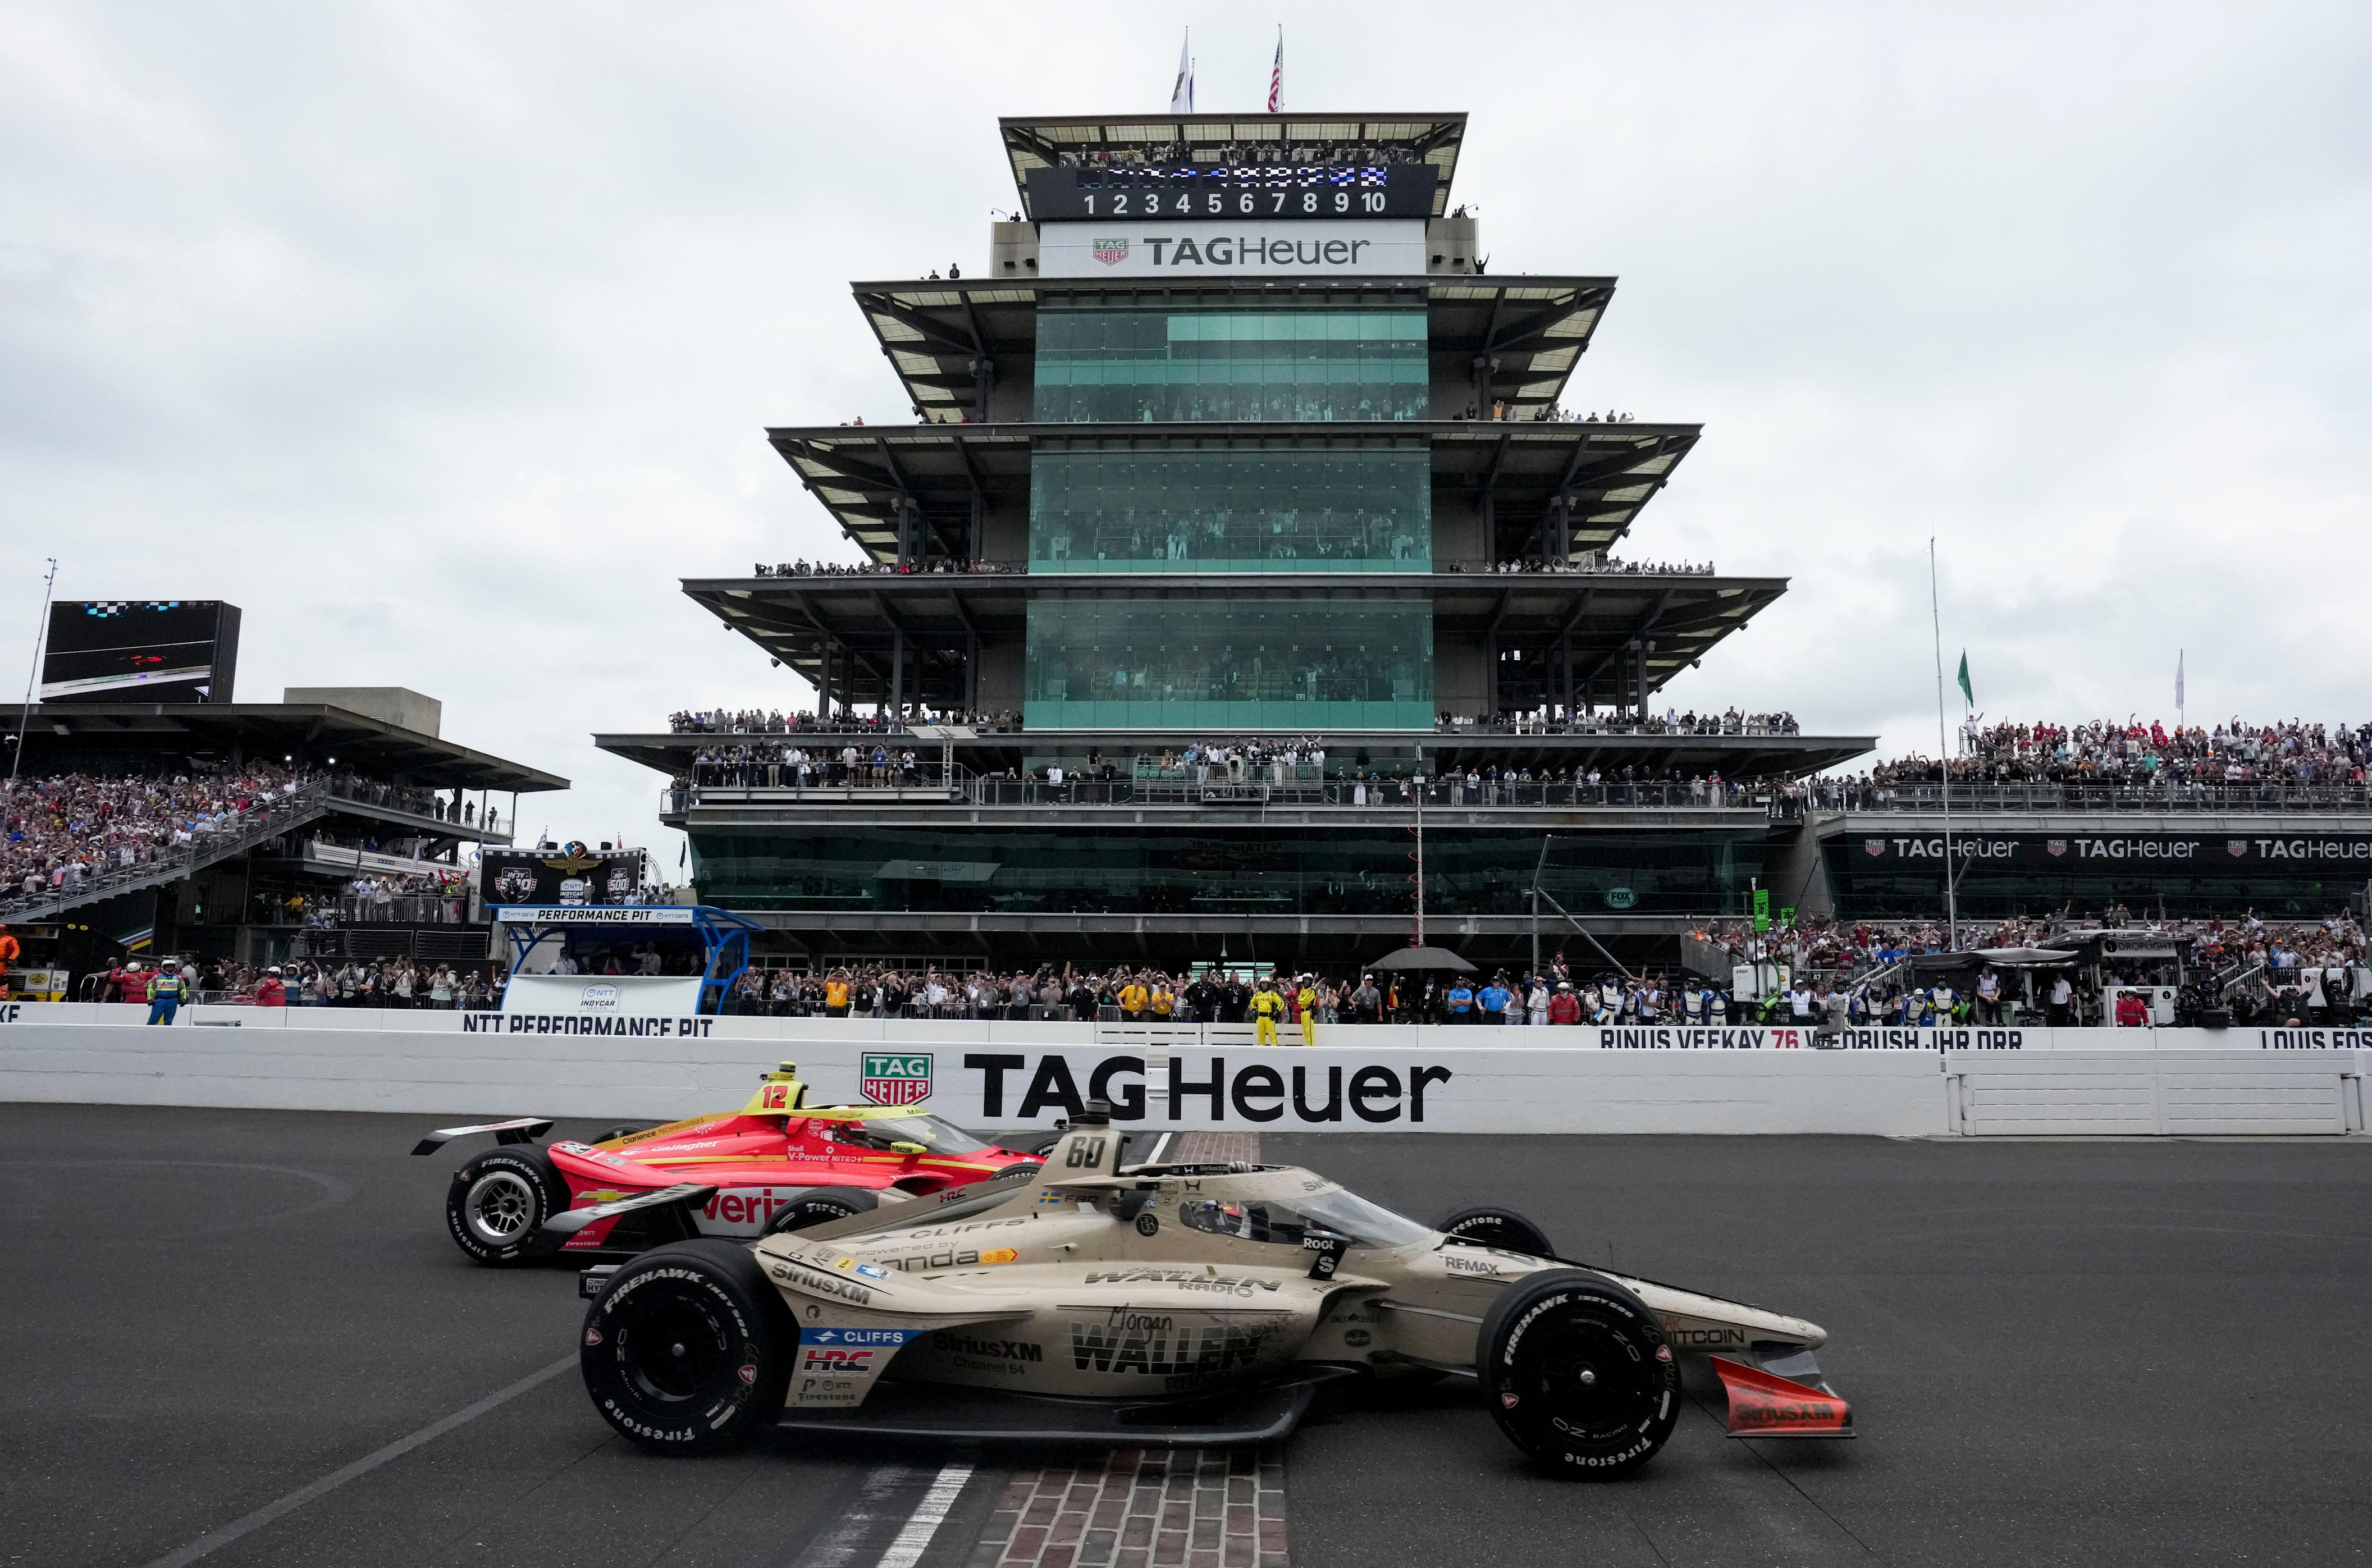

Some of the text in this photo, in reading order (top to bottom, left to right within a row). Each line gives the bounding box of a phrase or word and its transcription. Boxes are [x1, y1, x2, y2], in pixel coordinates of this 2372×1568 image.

[1084, 194, 1386, 214] 1 2 3 4 5 6 7 8 9 10
[1096, 240, 1127, 249] TAG
[1095, 251, 1127, 264] HEUER
[610, 879, 627, 892] 500
[1611, 892, 1631, 900] FOX
[538, 910, 652, 921] PERFORMANCE PIT
[1757, 902, 1766, 915] 76
[464, 1014, 712, 1037] NTT PERFORMANCE PIT
[1676, 1030, 1765, 1049] VEEKAY
[1771, 1030, 1798, 1049] 76
[866, 1057, 925, 1077] TAG
[762, 1085, 788, 1108] 12
[866, 1079, 928, 1104] HEUER
[623, 1130, 656, 1145] Clarience
[658, 1118, 705, 1135] TECHNOLOGIES
[651, 1141, 720, 1152] Gallagher
[1067, 1136, 1106, 1168] 60
[788, 1153, 830, 1162] V-Power
[481, 1158, 540, 1184] FIREHAWK
[939, 1187, 967, 1204] HRC
[451, 1210, 487, 1258] Firestone
[910, 1219, 1026, 1239] CLIFFS
[856, 1243, 933, 1256] Powered
[1303, 1237, 1334, 1250] Root
[1126, 1267, 1192, 1275] Morgan
[1445, 1256, 1500, 1276] REMAX
[604, 1268, 705, 1314] FIREHAWK
[772, 1263, 871, 1305] SiriusXM
[1084, 1271, 1286, 1292] WALLEN
[1179, 1282, 1254, 1298] RADIO
[1313, 1278, 1355, 1293] Firestone
[1109, 1302, 1172, 1345] Morgan
[1503, 1293, 1634, 1366] FIREHAWK INDY500
[844, 1331, 903, 1343] CLIFFS
[933, 1332, 1043, 1362] SiriusXM
[1070, 1322, 1265, 1375] WALLEN
[803, 1349, 875, 1372] HRC
[954, 1356, 1006, 1373] Channel
[798, 1393, 856, 1401] Firestone
[605, 1399, 696, 1442] Firestone
[1593, 1424, 1628, 1439] RACING
[1565, 1436, 1652, 1468] Firestone
